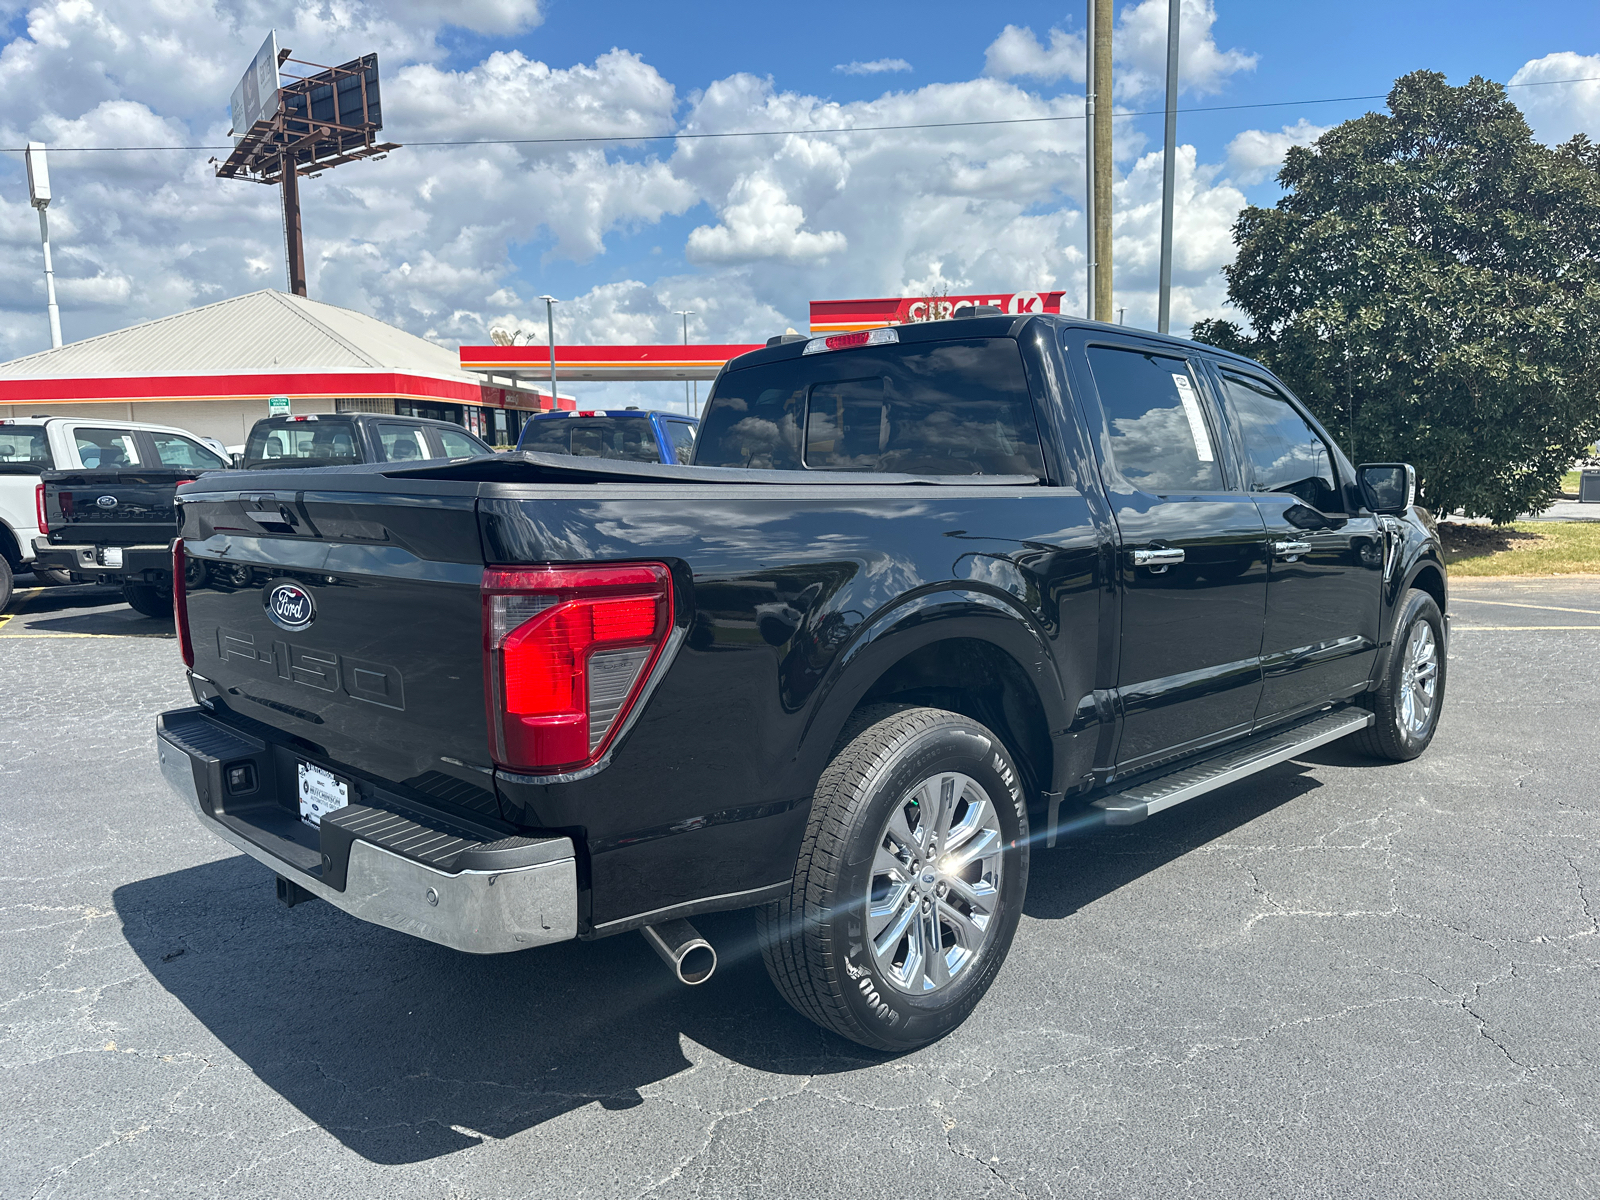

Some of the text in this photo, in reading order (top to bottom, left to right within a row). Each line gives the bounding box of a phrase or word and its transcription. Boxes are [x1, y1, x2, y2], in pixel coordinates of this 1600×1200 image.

[1017, 297, 1038, 314] K
[53, 511, 171, 519] SUPER DUTY
[276, 588, 305, 619] Ford
[216, 626, 406, 712] F-150
